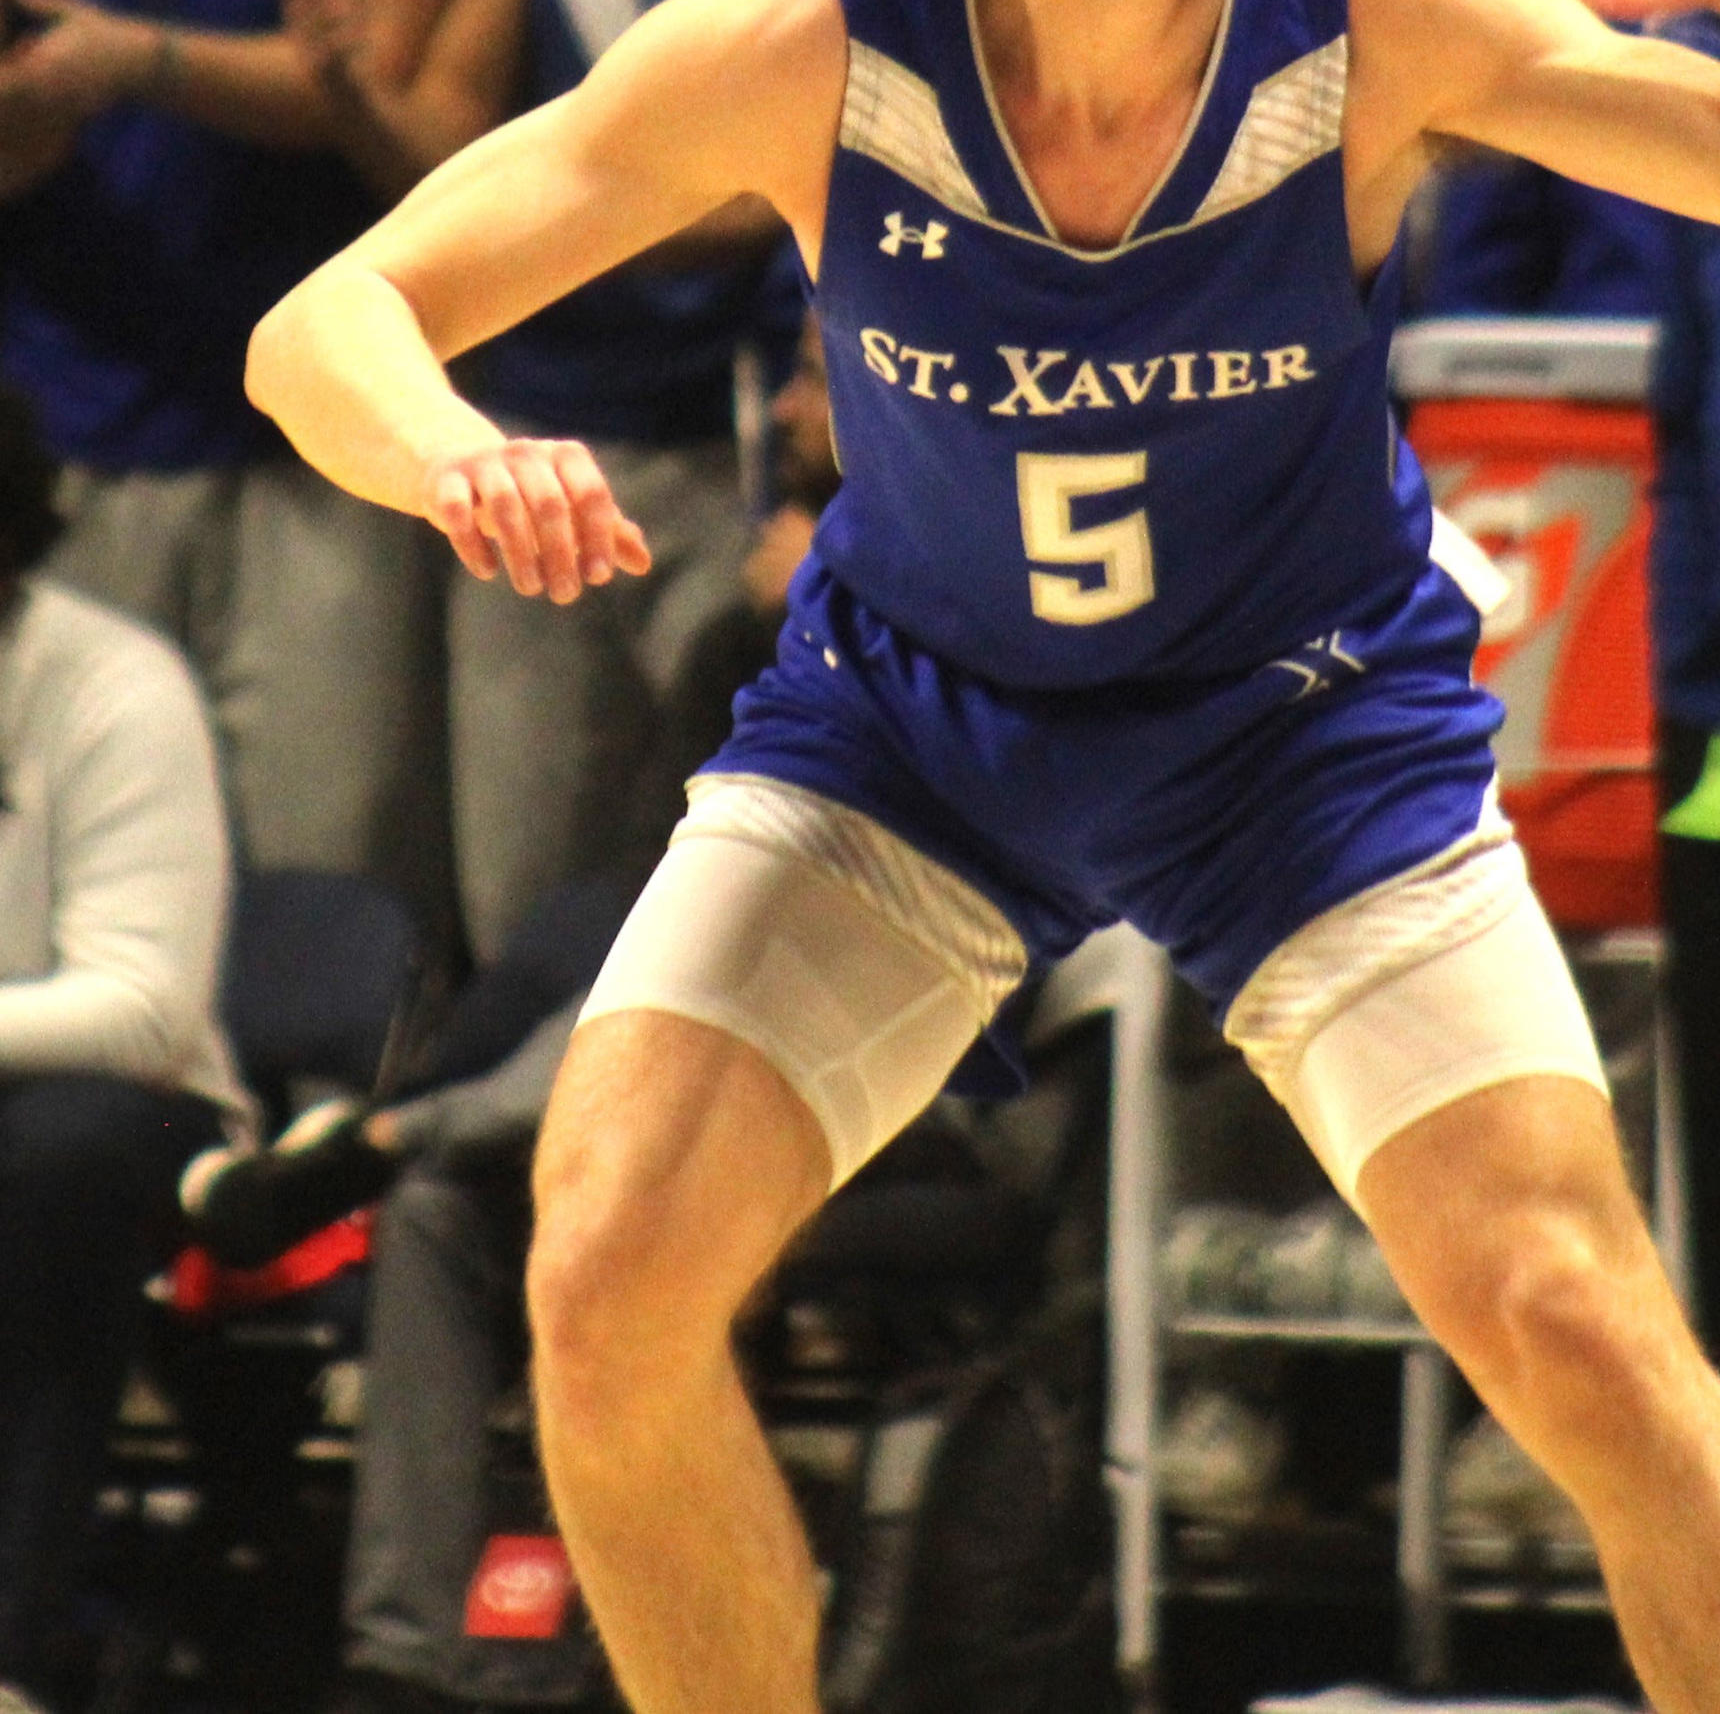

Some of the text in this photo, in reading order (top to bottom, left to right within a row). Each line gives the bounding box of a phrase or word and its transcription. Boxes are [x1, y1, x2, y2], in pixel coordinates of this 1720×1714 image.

[858, 326, 1317, 417] ST. XAVIER
[1015, 449, 1156, 626] 5
